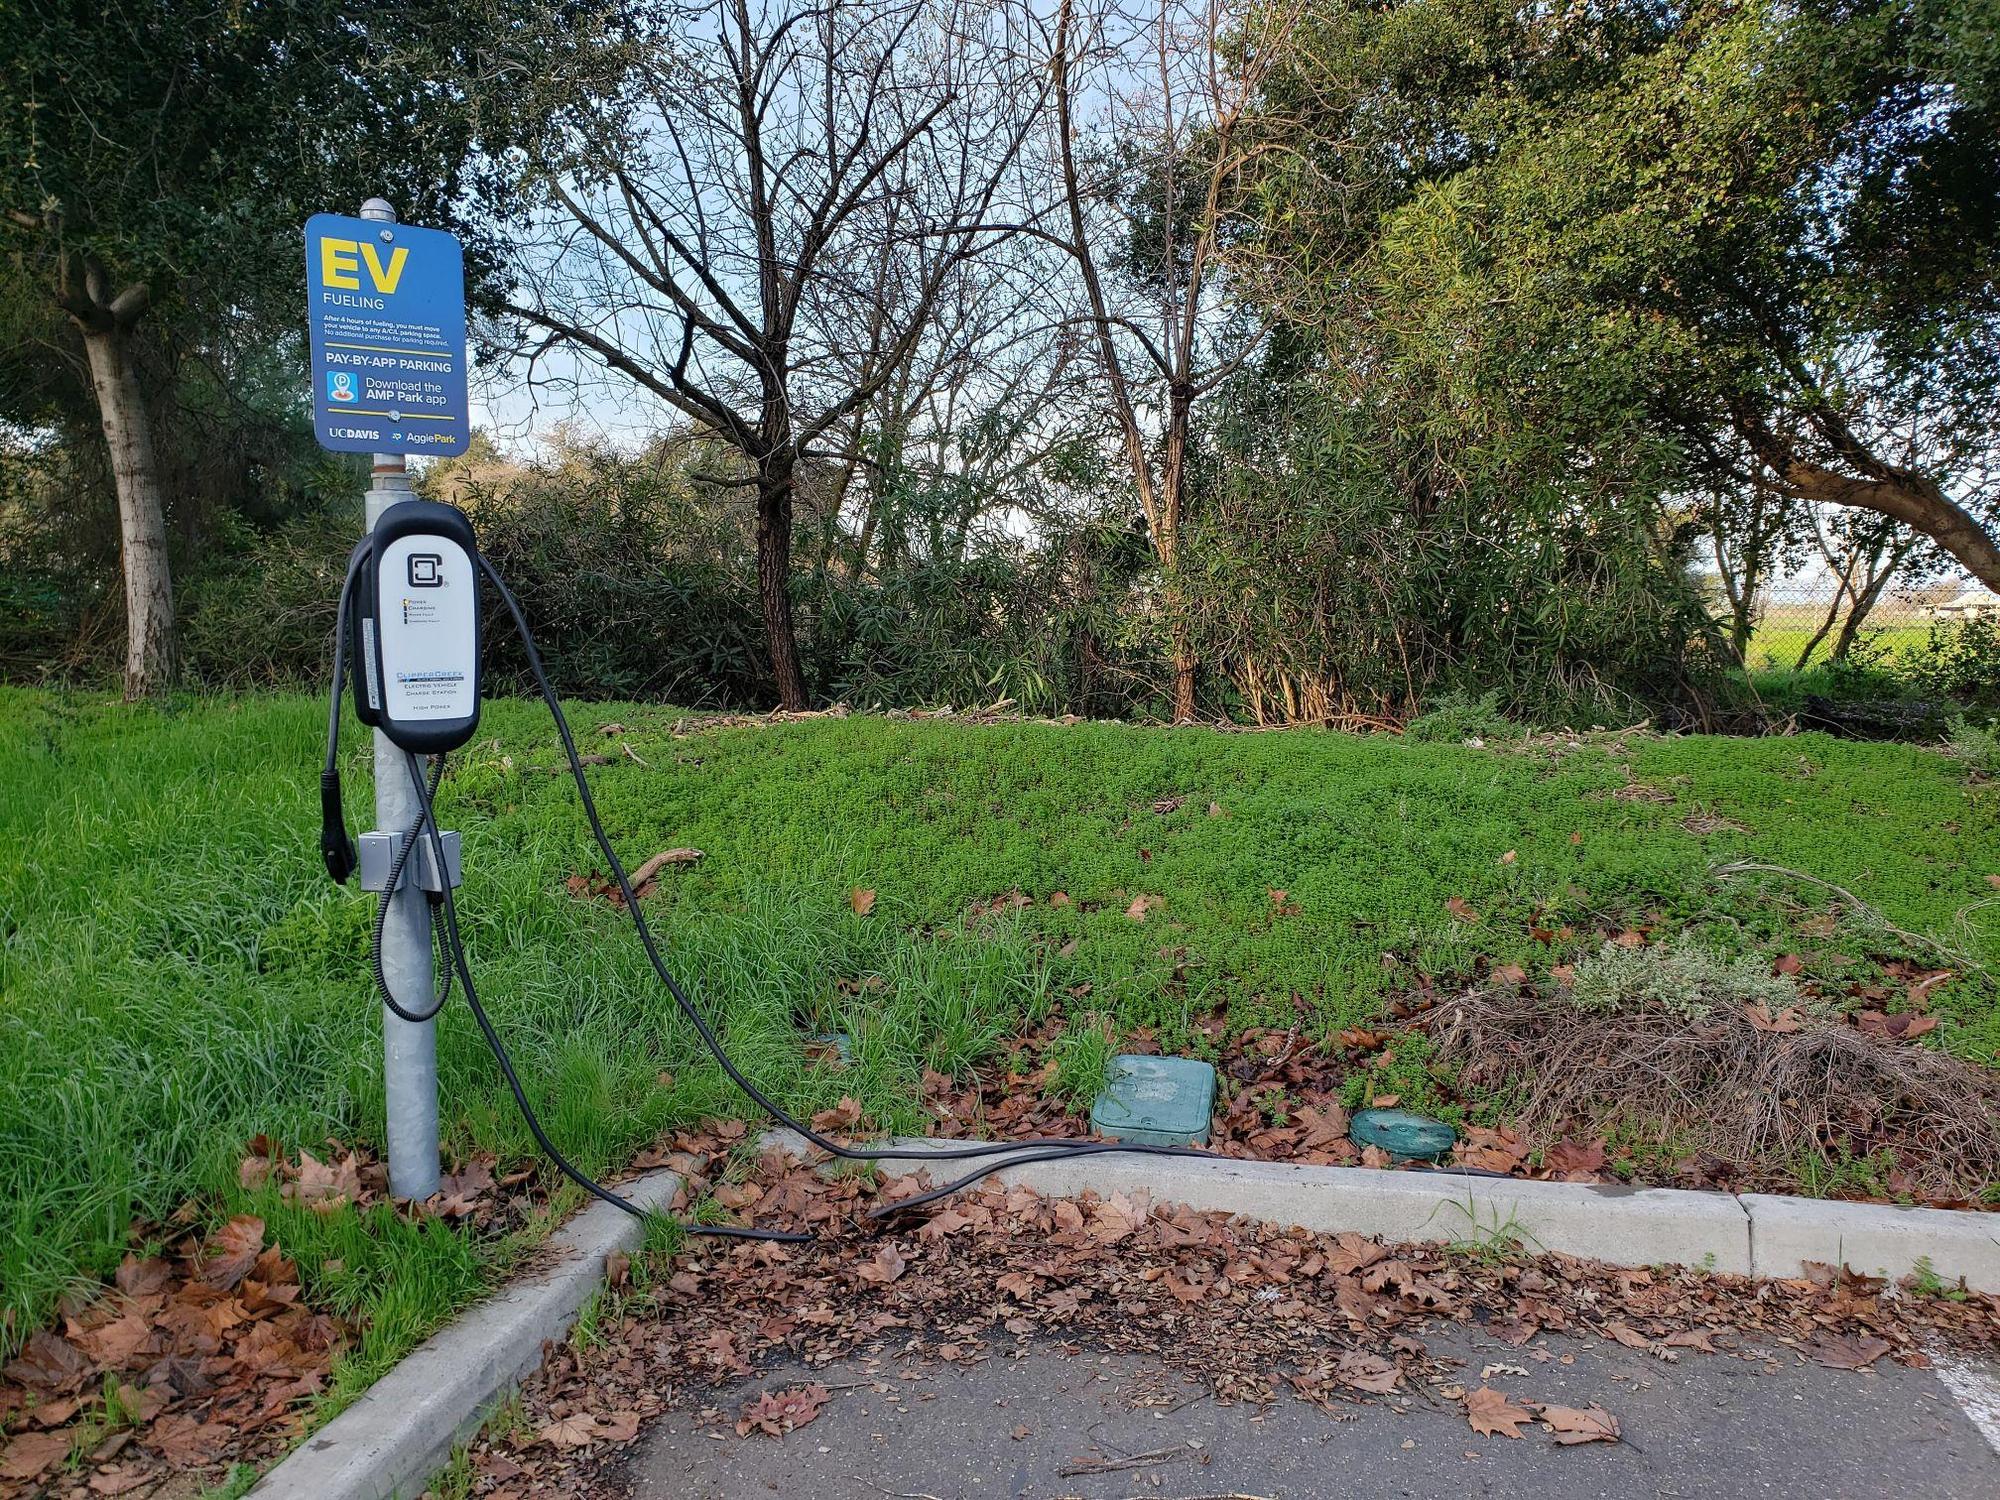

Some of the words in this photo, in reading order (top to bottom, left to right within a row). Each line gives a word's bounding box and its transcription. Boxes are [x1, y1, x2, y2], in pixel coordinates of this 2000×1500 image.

[320, 236, 410, 295] EV
[323, 292, 384, 310] FUELING
[323, 314, 340, 322] After
[346, 316, 364, 325] hours
[334, 330, 364, 338] additional
[364, 333, 392, 341] purchase
[402, 337, 423, 345] parking
[338, 323, 361, 331] vehicle
[400, 330, 422, 338] parking
[325, 352, 397, 368] PAY-BY-APP
[400, 359, 453, 373] PARKING
[366, 377, 422, 391] Download
[424, 381, 442, 393] the
[366, 389, 395, 400] AMP
[398, 391, 424, 403] Park
[425, 395, 447, 406] app
